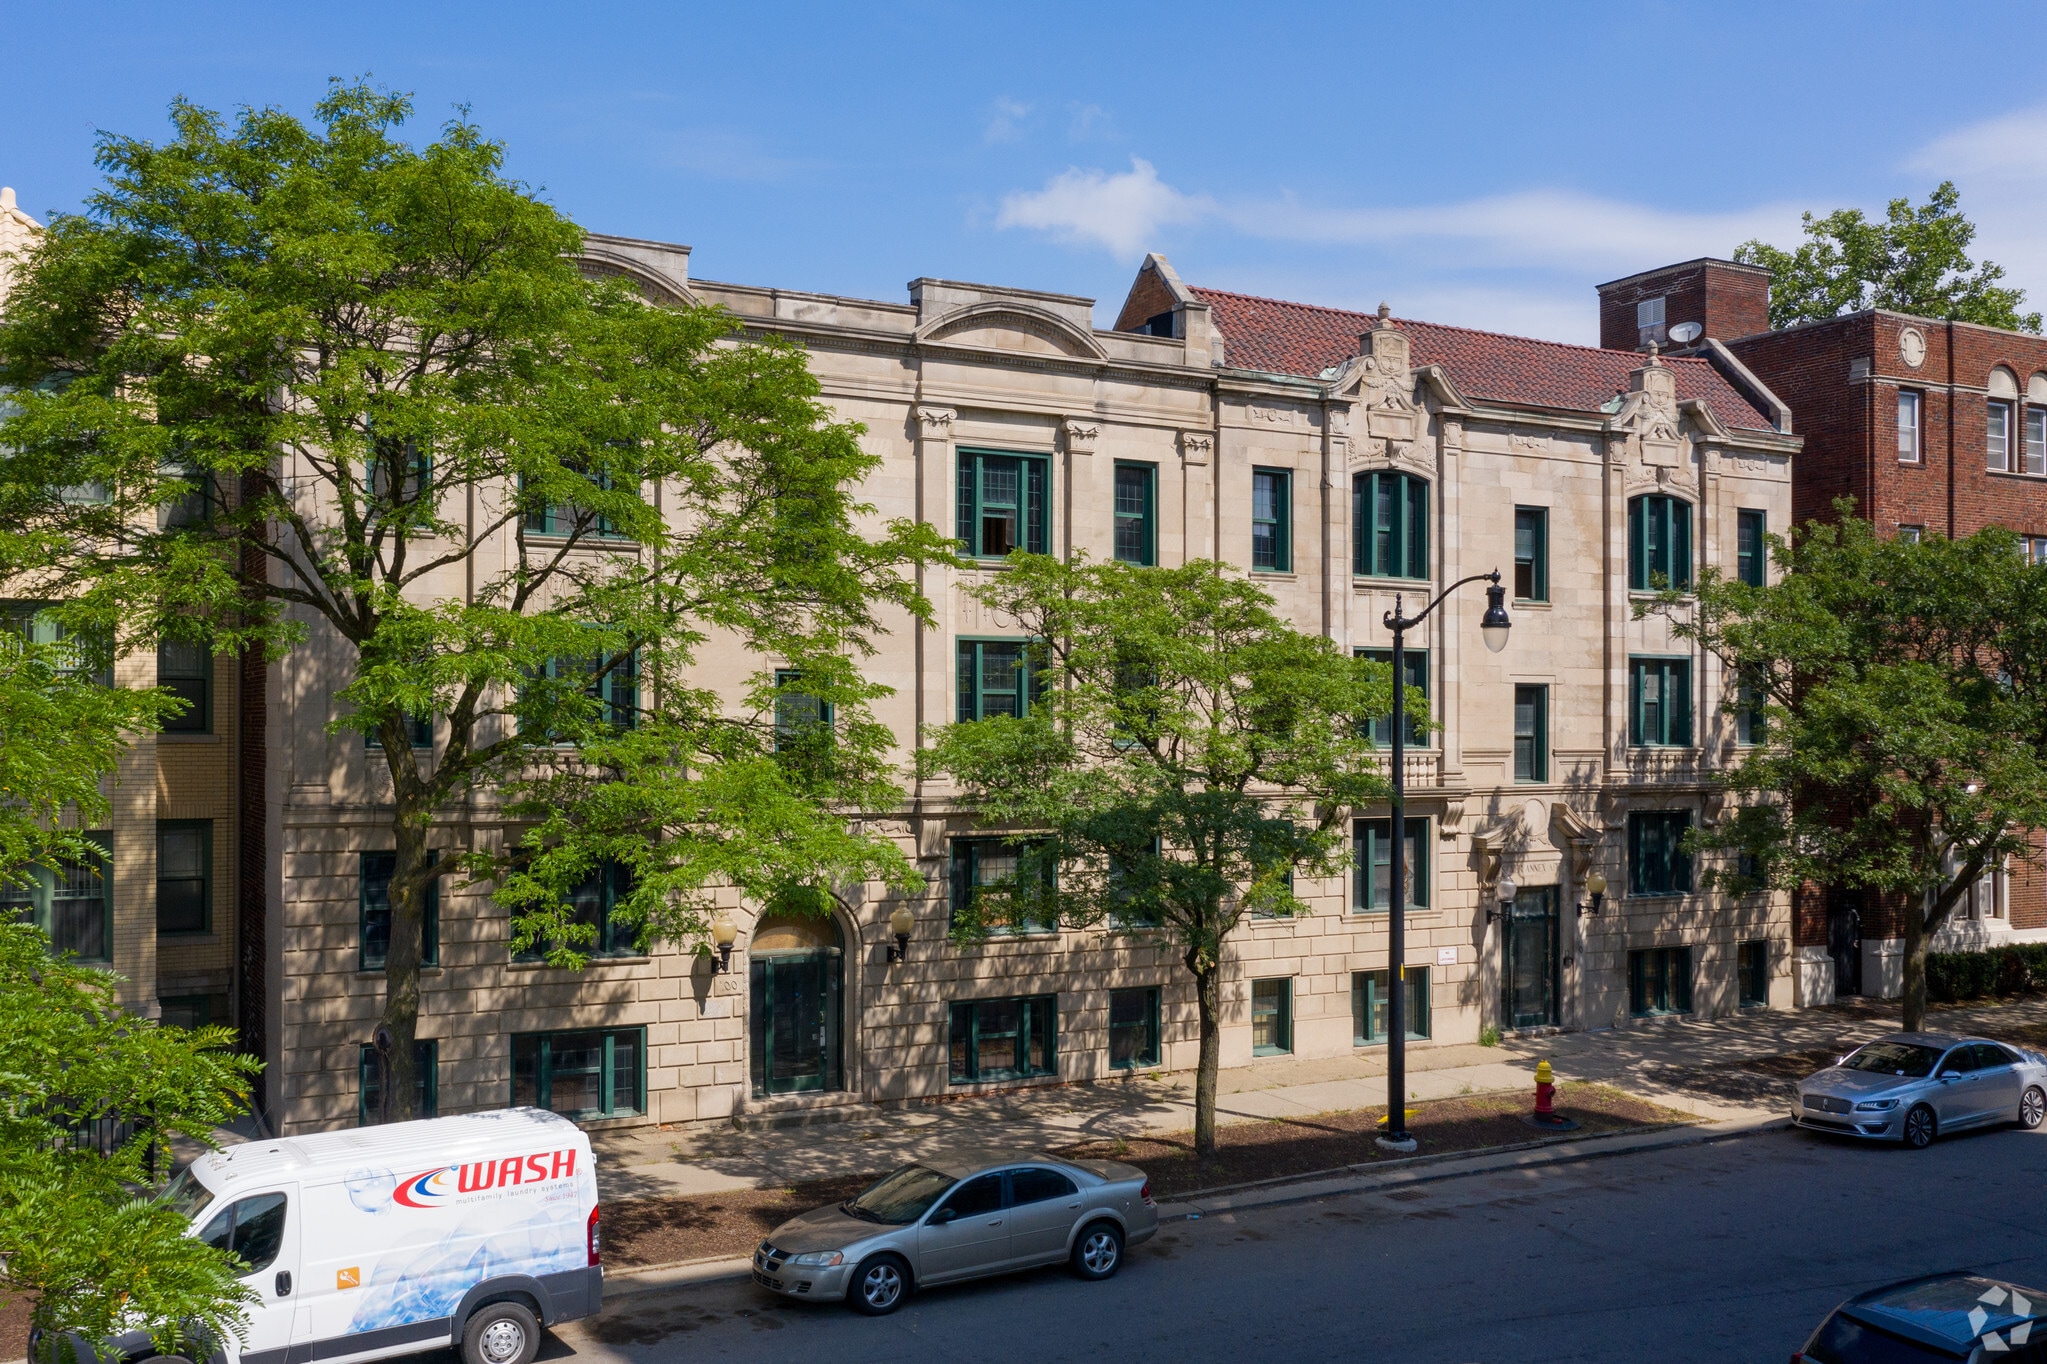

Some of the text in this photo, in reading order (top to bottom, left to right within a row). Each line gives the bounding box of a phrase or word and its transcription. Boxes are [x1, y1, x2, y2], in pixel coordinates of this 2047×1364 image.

[458, 1149, 576, 1193] WASH
[455, 1182, 574, 1205] multifamily laundry systems
[545, 1194, 561, 1202] Since
